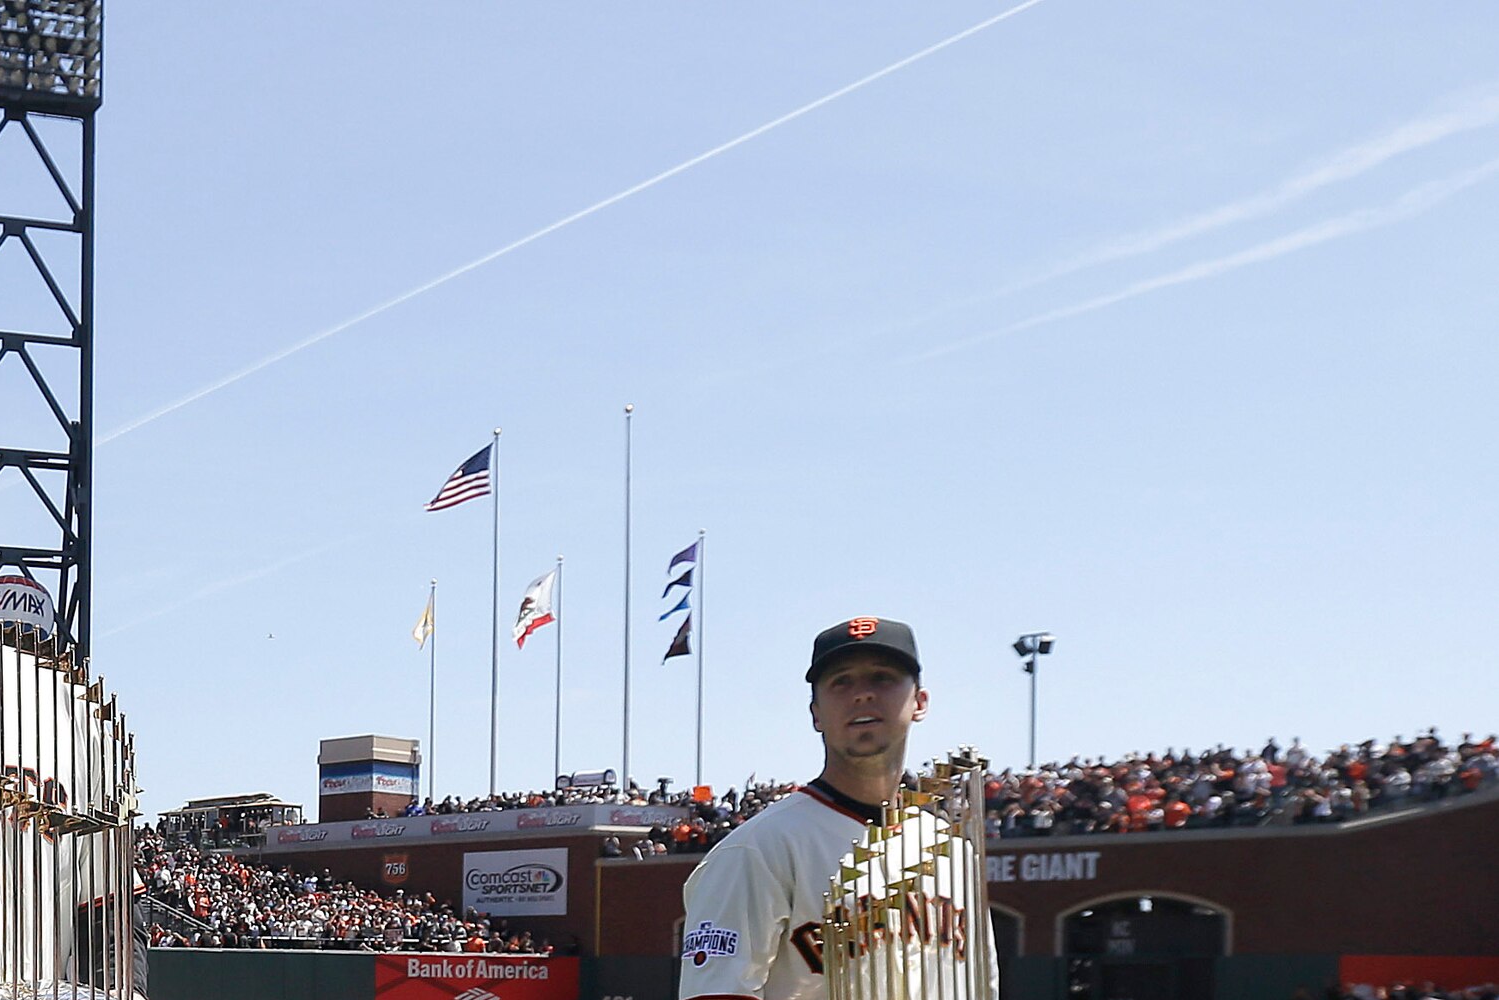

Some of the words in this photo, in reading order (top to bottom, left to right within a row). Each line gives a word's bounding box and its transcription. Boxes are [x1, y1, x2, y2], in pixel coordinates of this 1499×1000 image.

[385, 863, 406, 875] 756
[986, 855, 1016, 882] RE
[1020, 851, 1101, 880] GIANT
[482, 883, 550, 895] SPORTSNET
[408, 958, 453, 978] Bank
[455, 959, 475, 978] of
[476, 960, 548, 980] America
